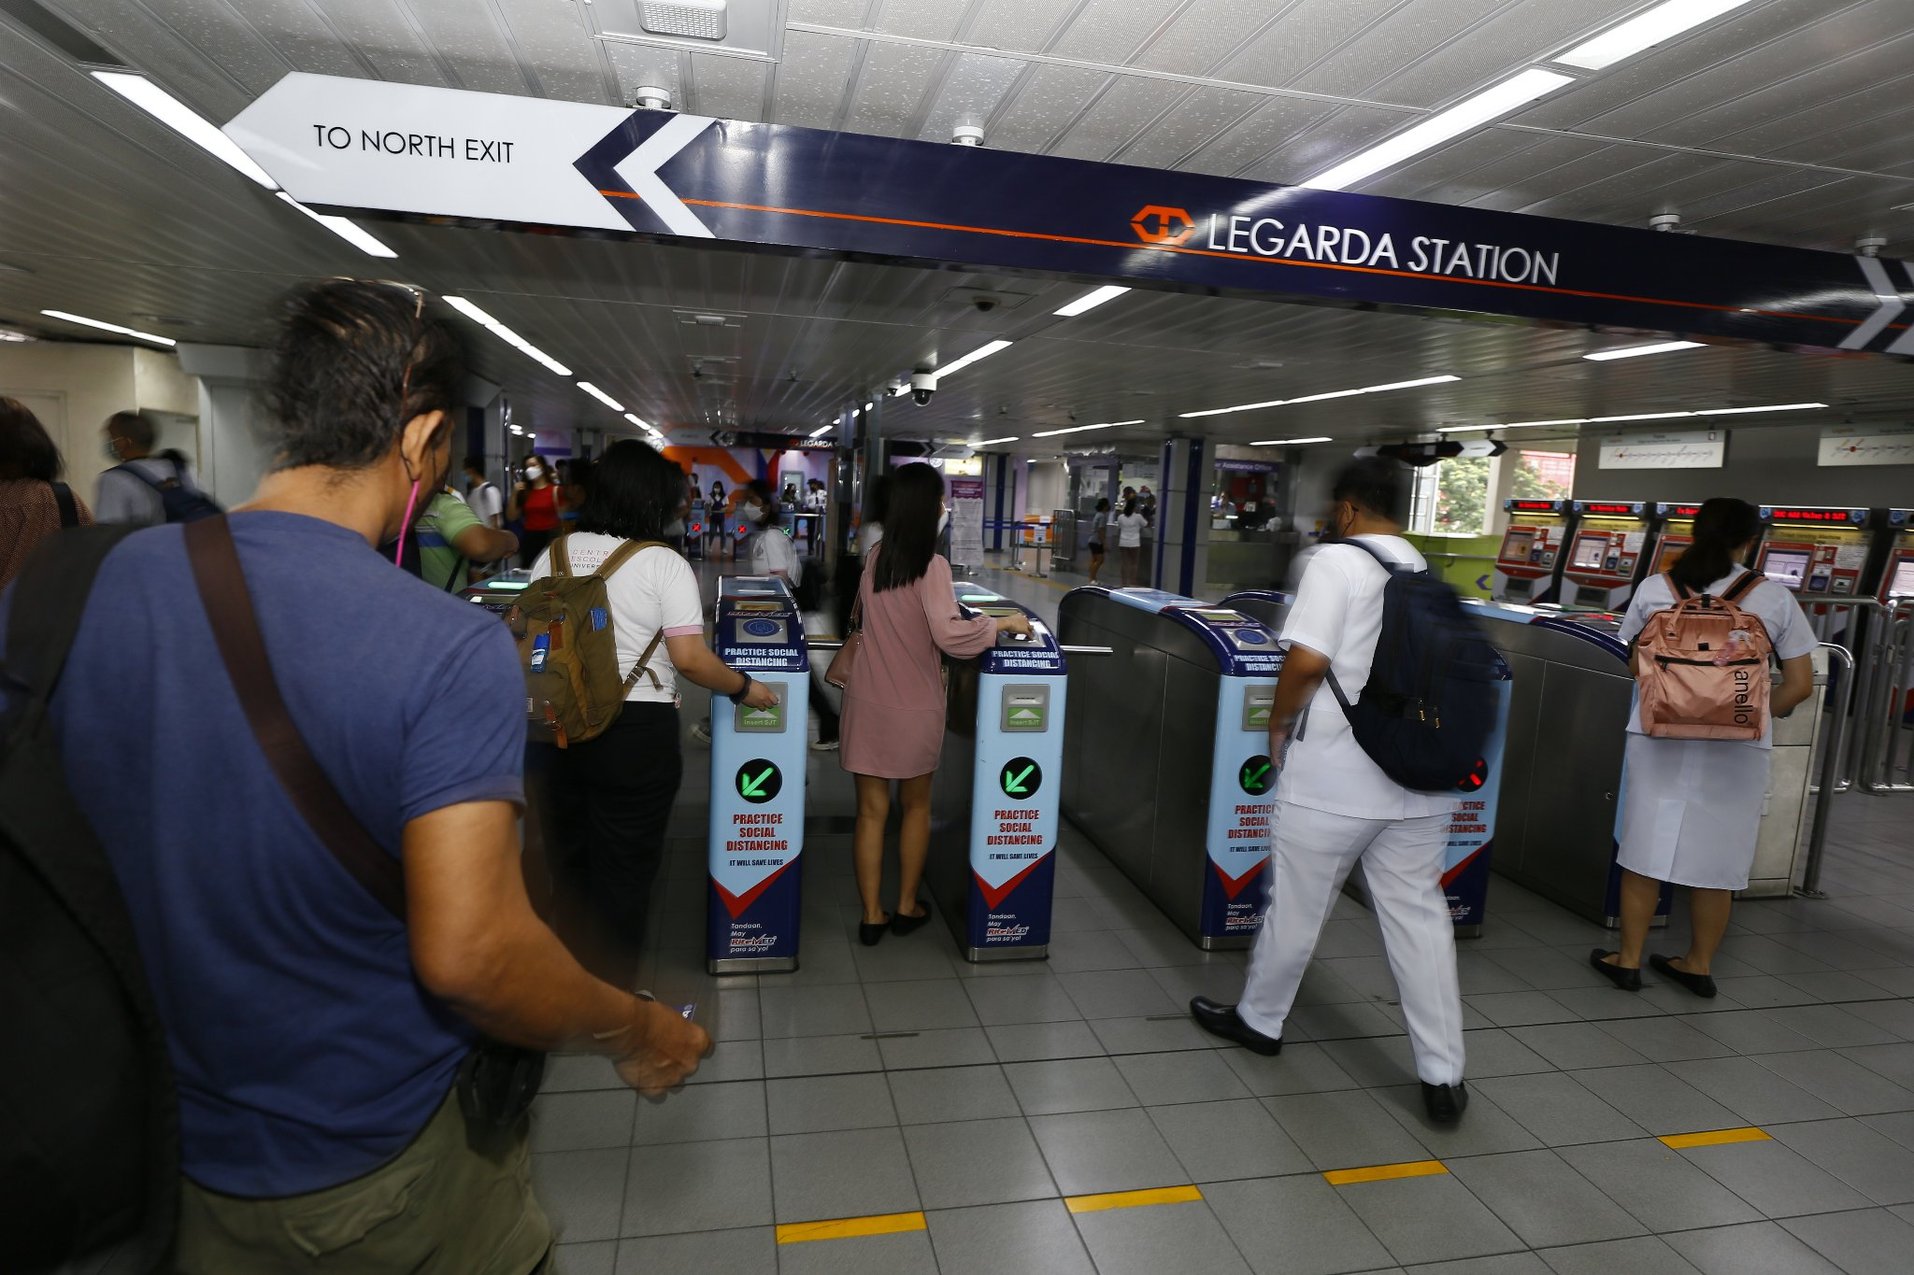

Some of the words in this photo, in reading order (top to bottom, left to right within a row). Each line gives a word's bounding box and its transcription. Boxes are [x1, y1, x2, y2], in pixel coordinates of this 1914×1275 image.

[313, 124, 351, 149] TO
[361, 129, 455, 159] NORTH
[465, 138, 514, 163] EXIT
[1206, 213, 1399, 269] LEGARDA
[1408, 236, 1560, 286] STATION
[800, 440, 833, 448] LEGARDA
[573, 550, 609, 558] CENTR
[725, 648, 766, 656] PRACTICE
[768, 648, 798, 656] SOCIAL
[992, 650, 1030, 658] PRACTICE
[1031, 651, 1060, 659] SOCIAL
[736, 657, 788, 667] DISTANCING
[1004, 659, 1051, 668] DISTANCING
[1734, 670, 1753, 724] anello
[733, 813, 783, 824] PRACTICE
[994, 809, 1040, 820] PRACTICE
[1239, 816, 1269, 826] SOCIAL
[1000, 822, 1032, 832] SOCIAL
[739, 827, 776, 838] SOCIAL
[1228, 828, 1271, 839] DISTANCI
[987, 834, 1043, 845] DISTANCING
[726, 840, 788, 851] DISTANCING
[767, 858, 784, 866] LIVES
